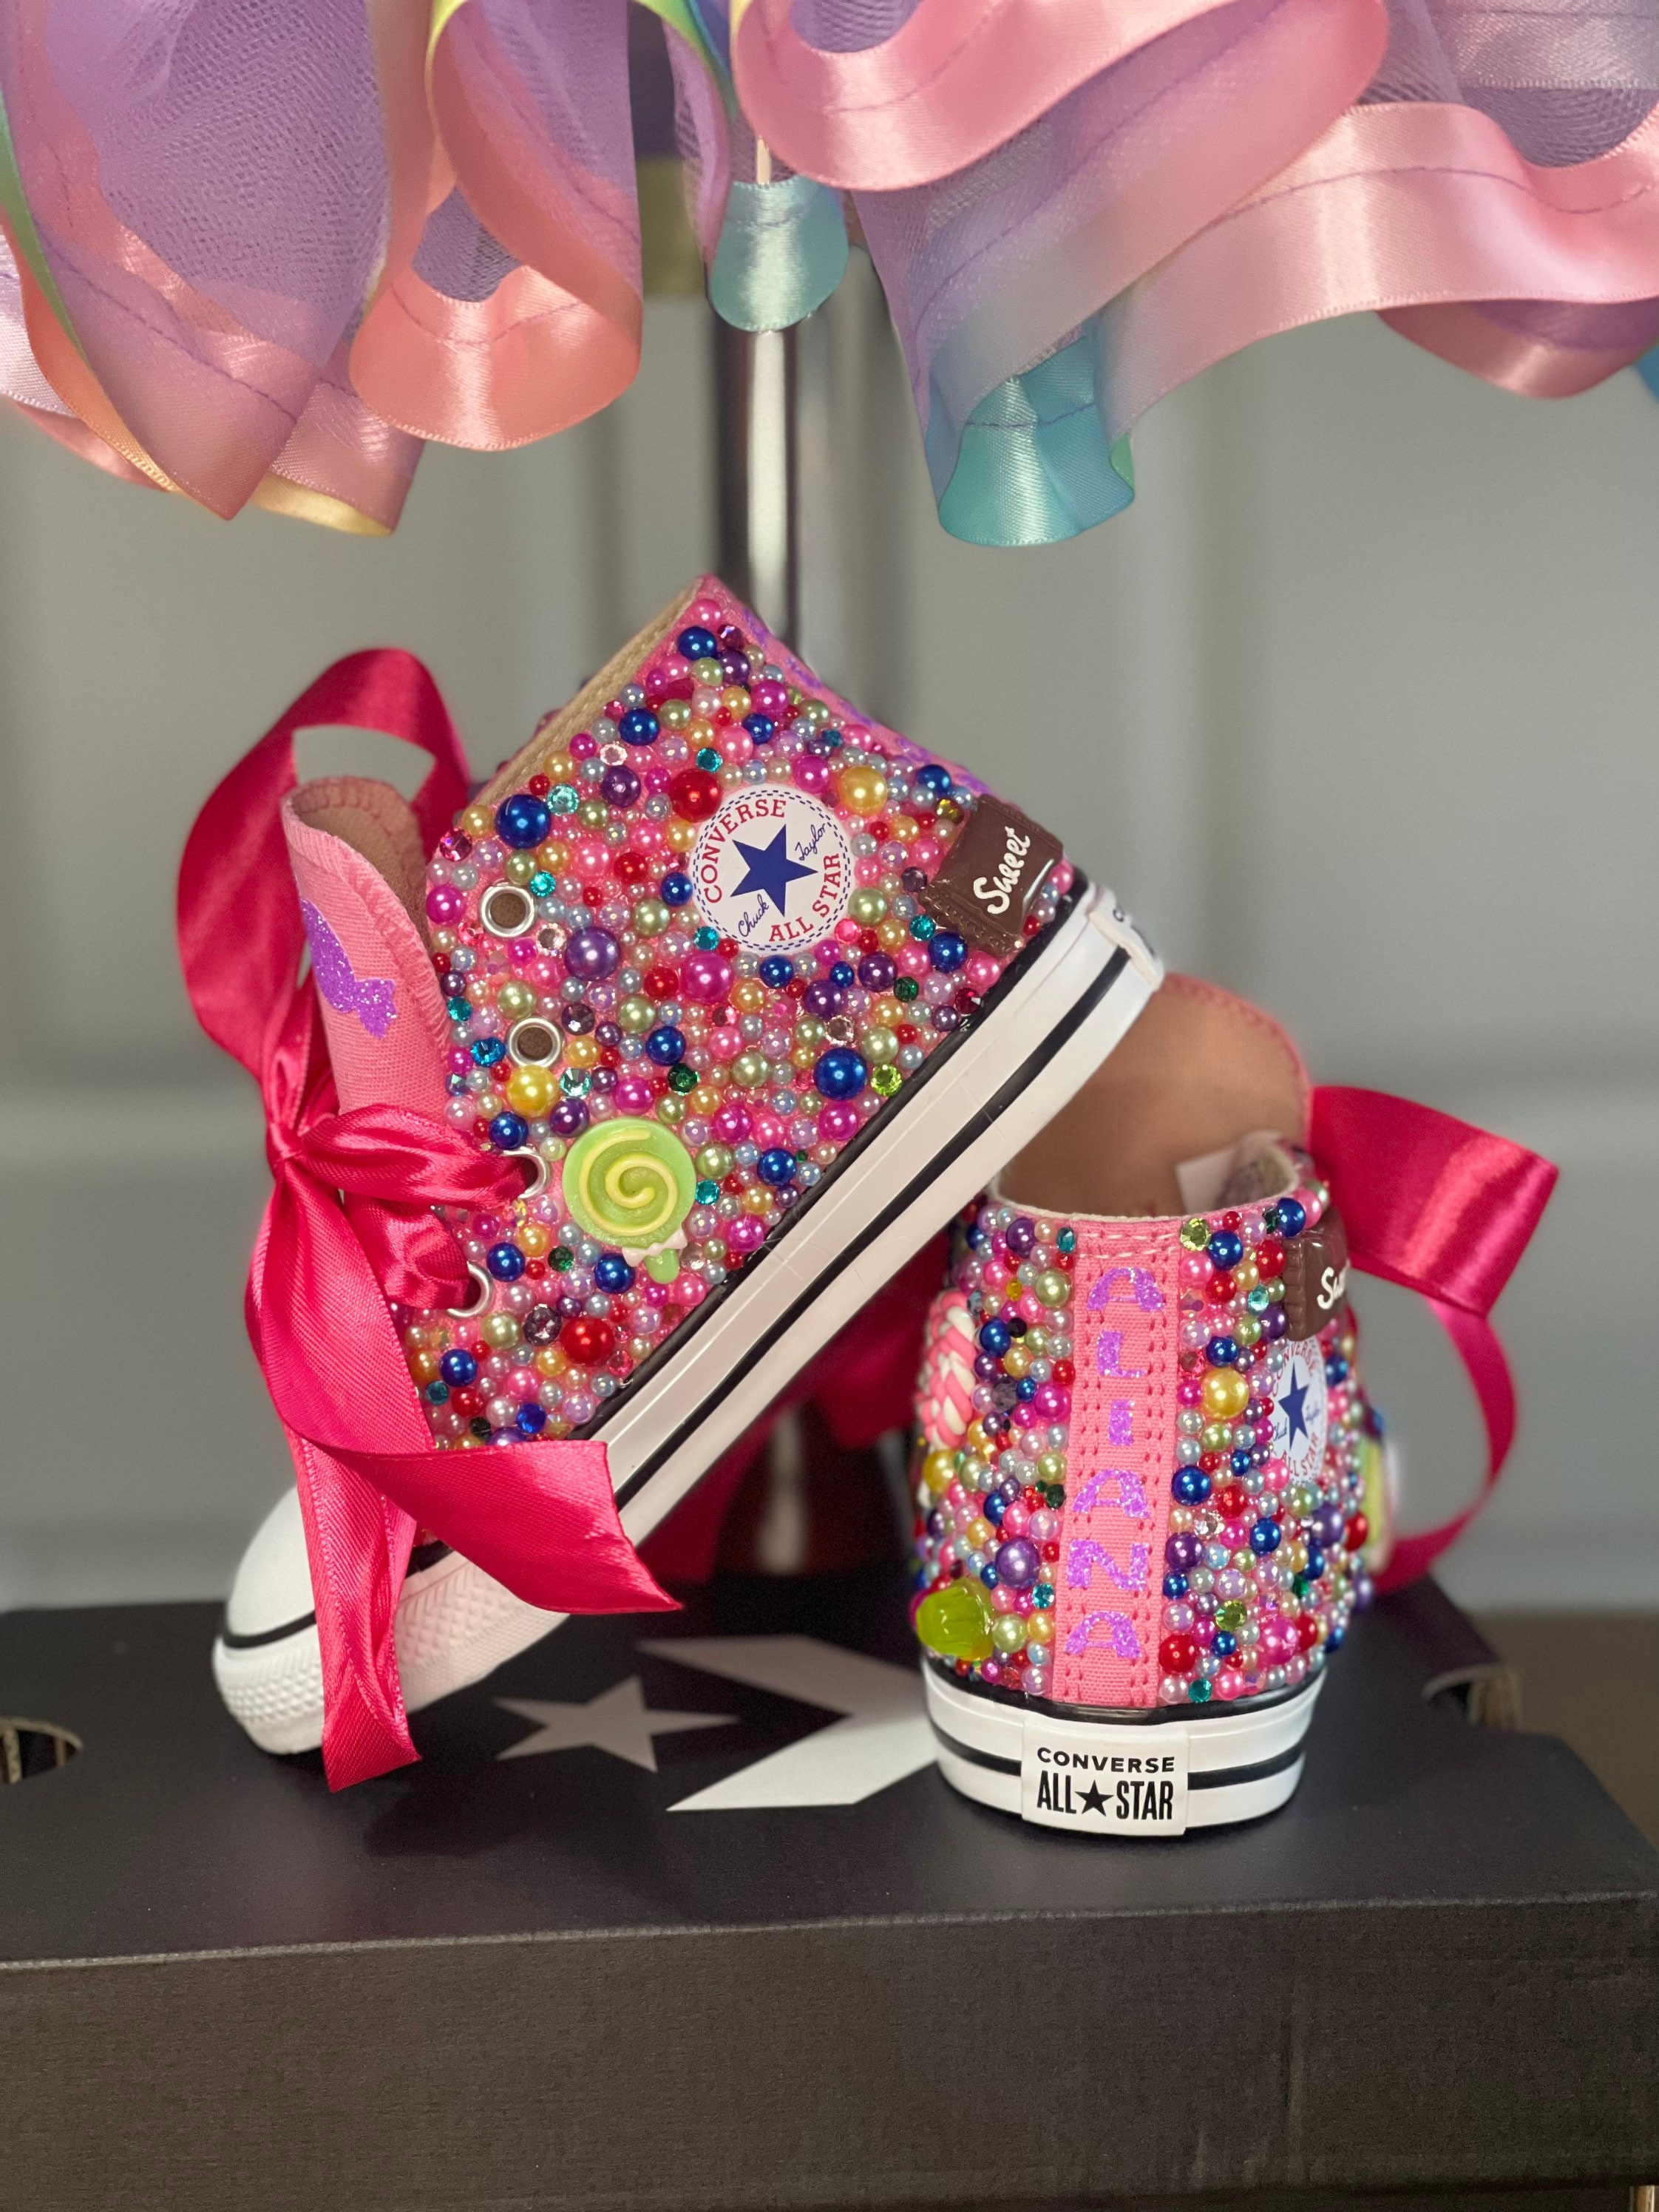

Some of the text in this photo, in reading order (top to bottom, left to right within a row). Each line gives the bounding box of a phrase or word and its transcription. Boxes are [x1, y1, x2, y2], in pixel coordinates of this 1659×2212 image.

[700, 798, 787, 903] CONVERSE
[795, 823, 826, 861] Taylor
[973, 825, 1031, 915] Sweet
[738, 893, 770, 937] Chuck
[768, 853, 841, 943] ALL STAR
[1037, 1746, 1175, 1774] CONVERSE
[1037, 1770, 1174, 1820] ALL STAR
